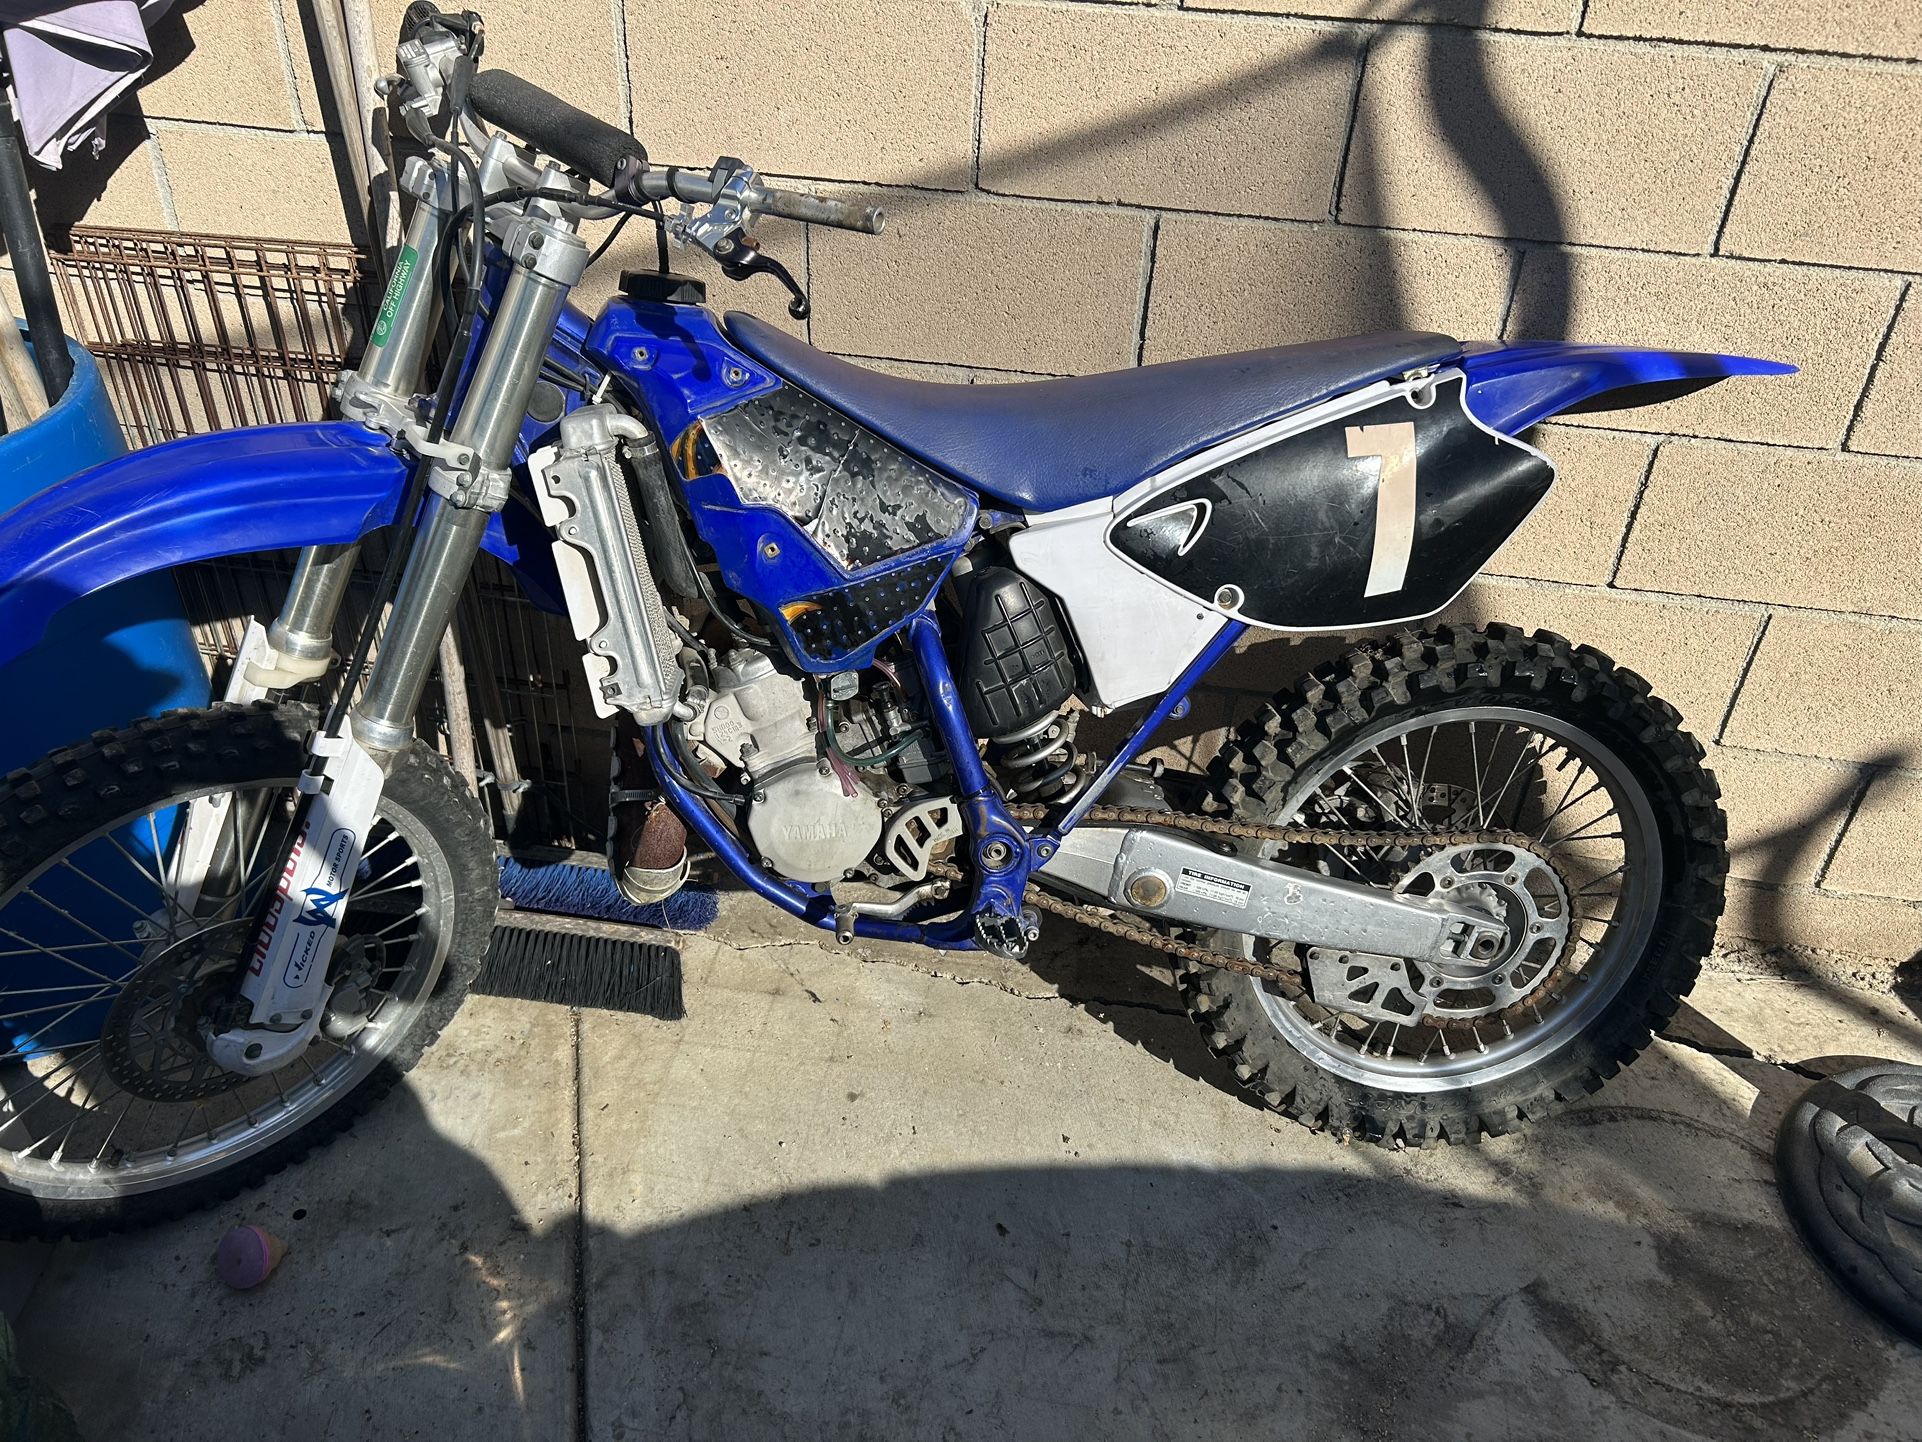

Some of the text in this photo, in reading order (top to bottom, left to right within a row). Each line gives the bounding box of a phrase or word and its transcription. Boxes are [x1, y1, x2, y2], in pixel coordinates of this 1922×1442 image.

[383, 261, 404, 310] CALIFORNIA
[386, 259, 412, 318] OFF HIGHWAY
[782, 823, 848, 841] YAMAHA
[326, 834, 350, 889] MOTOR SPORTS
[1188, 870, 1245, 889] TIRE INFORMATION
